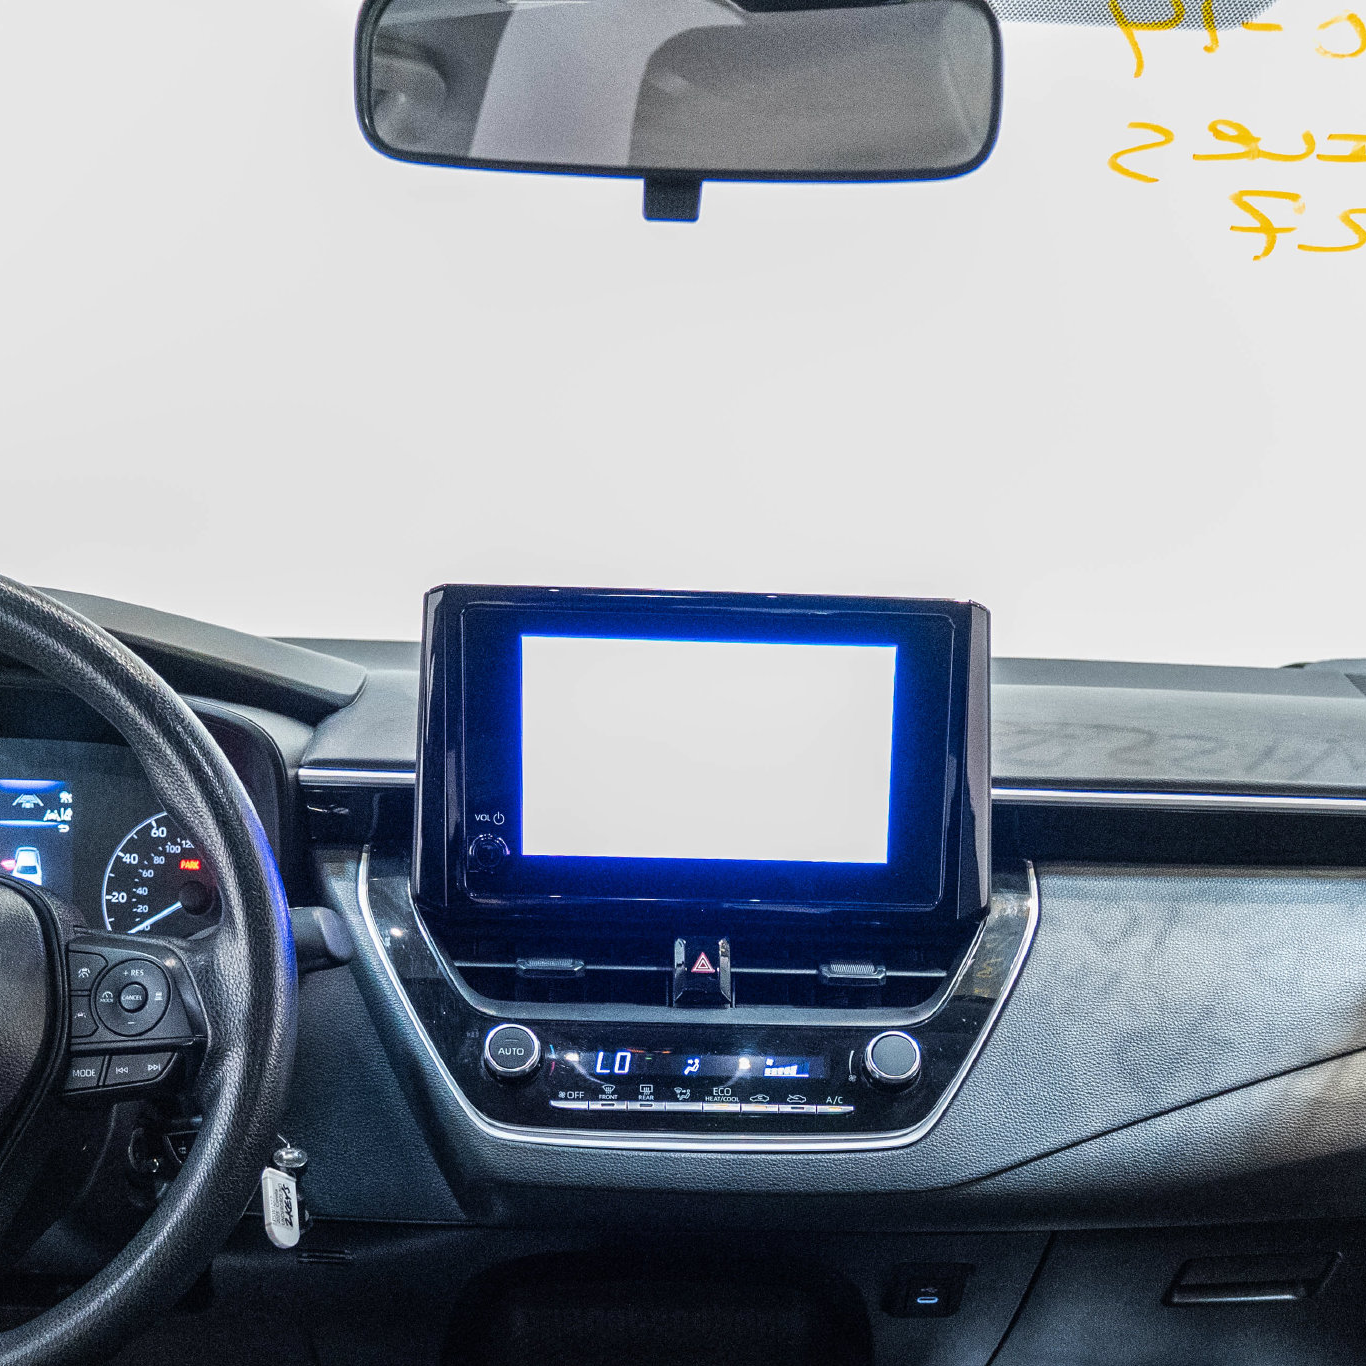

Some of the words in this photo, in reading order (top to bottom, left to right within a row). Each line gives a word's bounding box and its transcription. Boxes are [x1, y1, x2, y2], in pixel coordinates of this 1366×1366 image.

[151, 827, 167, 838] 60
[165, 845, 181, 854] 100
[122, 853, 138, 864] 40
[153, 856, 165, 864] 80
[180, 860, 200, 869] PARK
[142, 869, 154, 877] 60
[136, 887, 148, 895] 40
[111, 892, 127, 903] 20
[137, 905, 148, 913] 20
[498, 1047, 525, 1056] AUTO
[596, 1051, 632, 1074] LO
[72, 1069, 96, 1077] MODE
[567, 1091, 585, 1099] OFF
[713, 1087, 732, 1096] ECO
[826, 1096, 843, 1104] A/C
